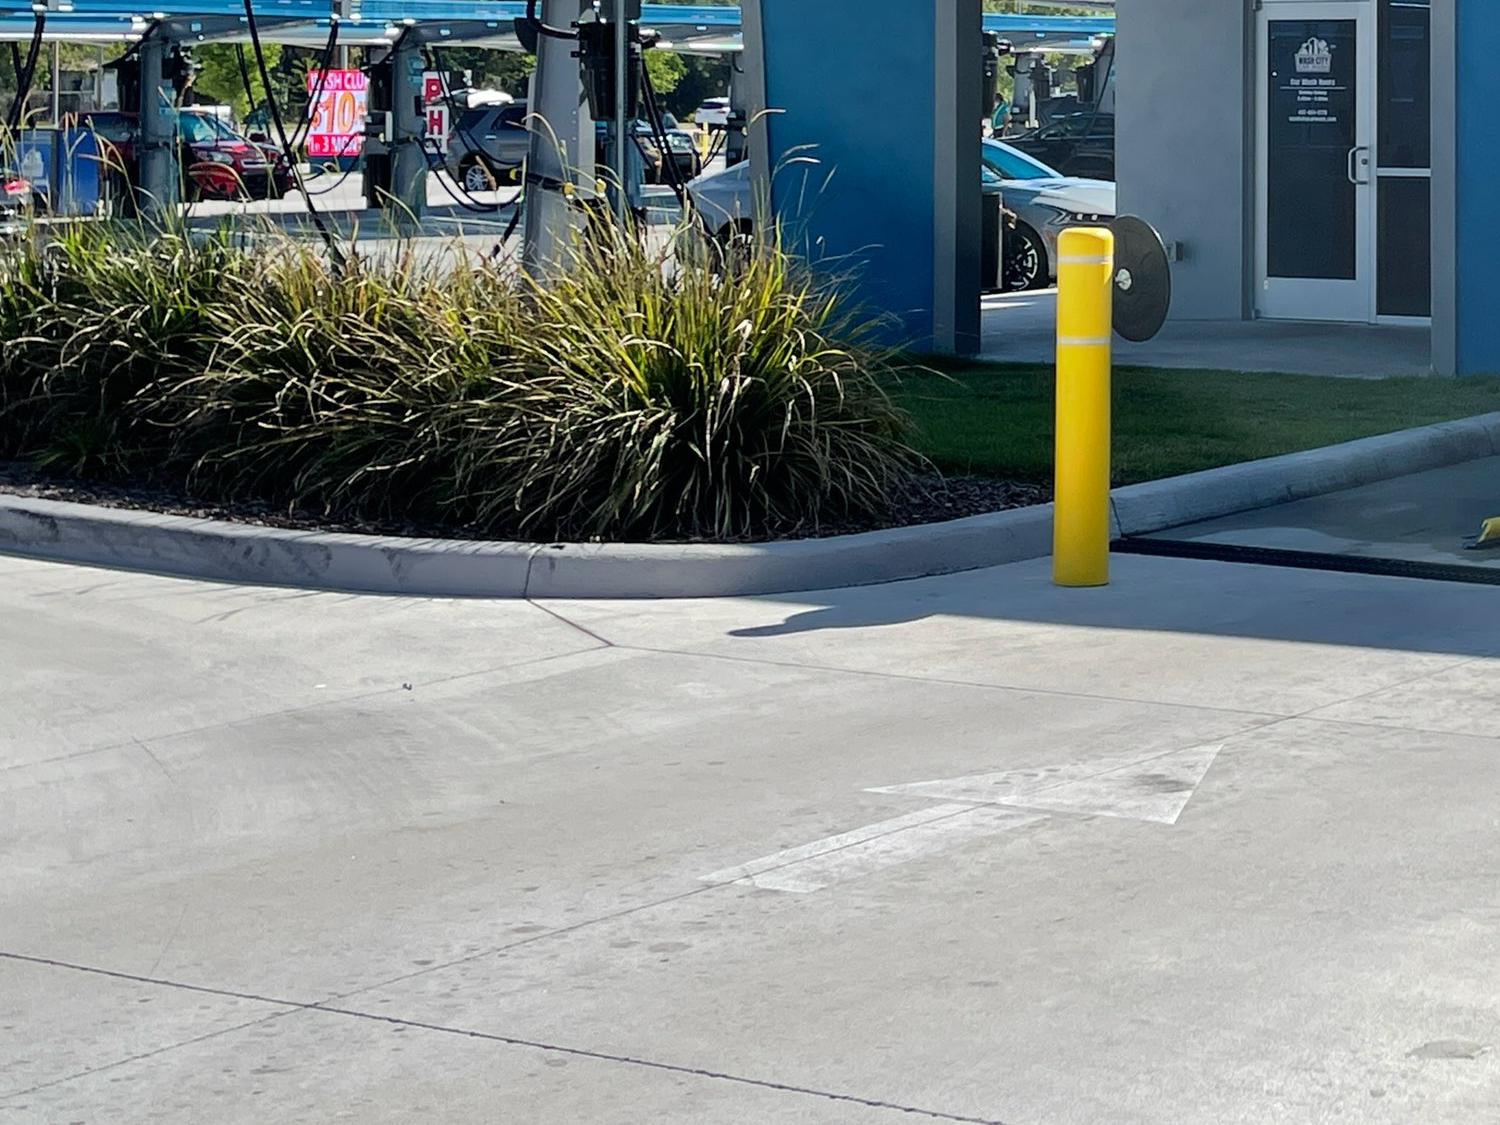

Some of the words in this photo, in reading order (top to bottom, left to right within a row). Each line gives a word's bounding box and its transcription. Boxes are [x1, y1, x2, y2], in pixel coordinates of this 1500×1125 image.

[310, 72, 342, 89] WSH
[344, 72, 366, 89] CLU
[429, 110, 443, 135] H
